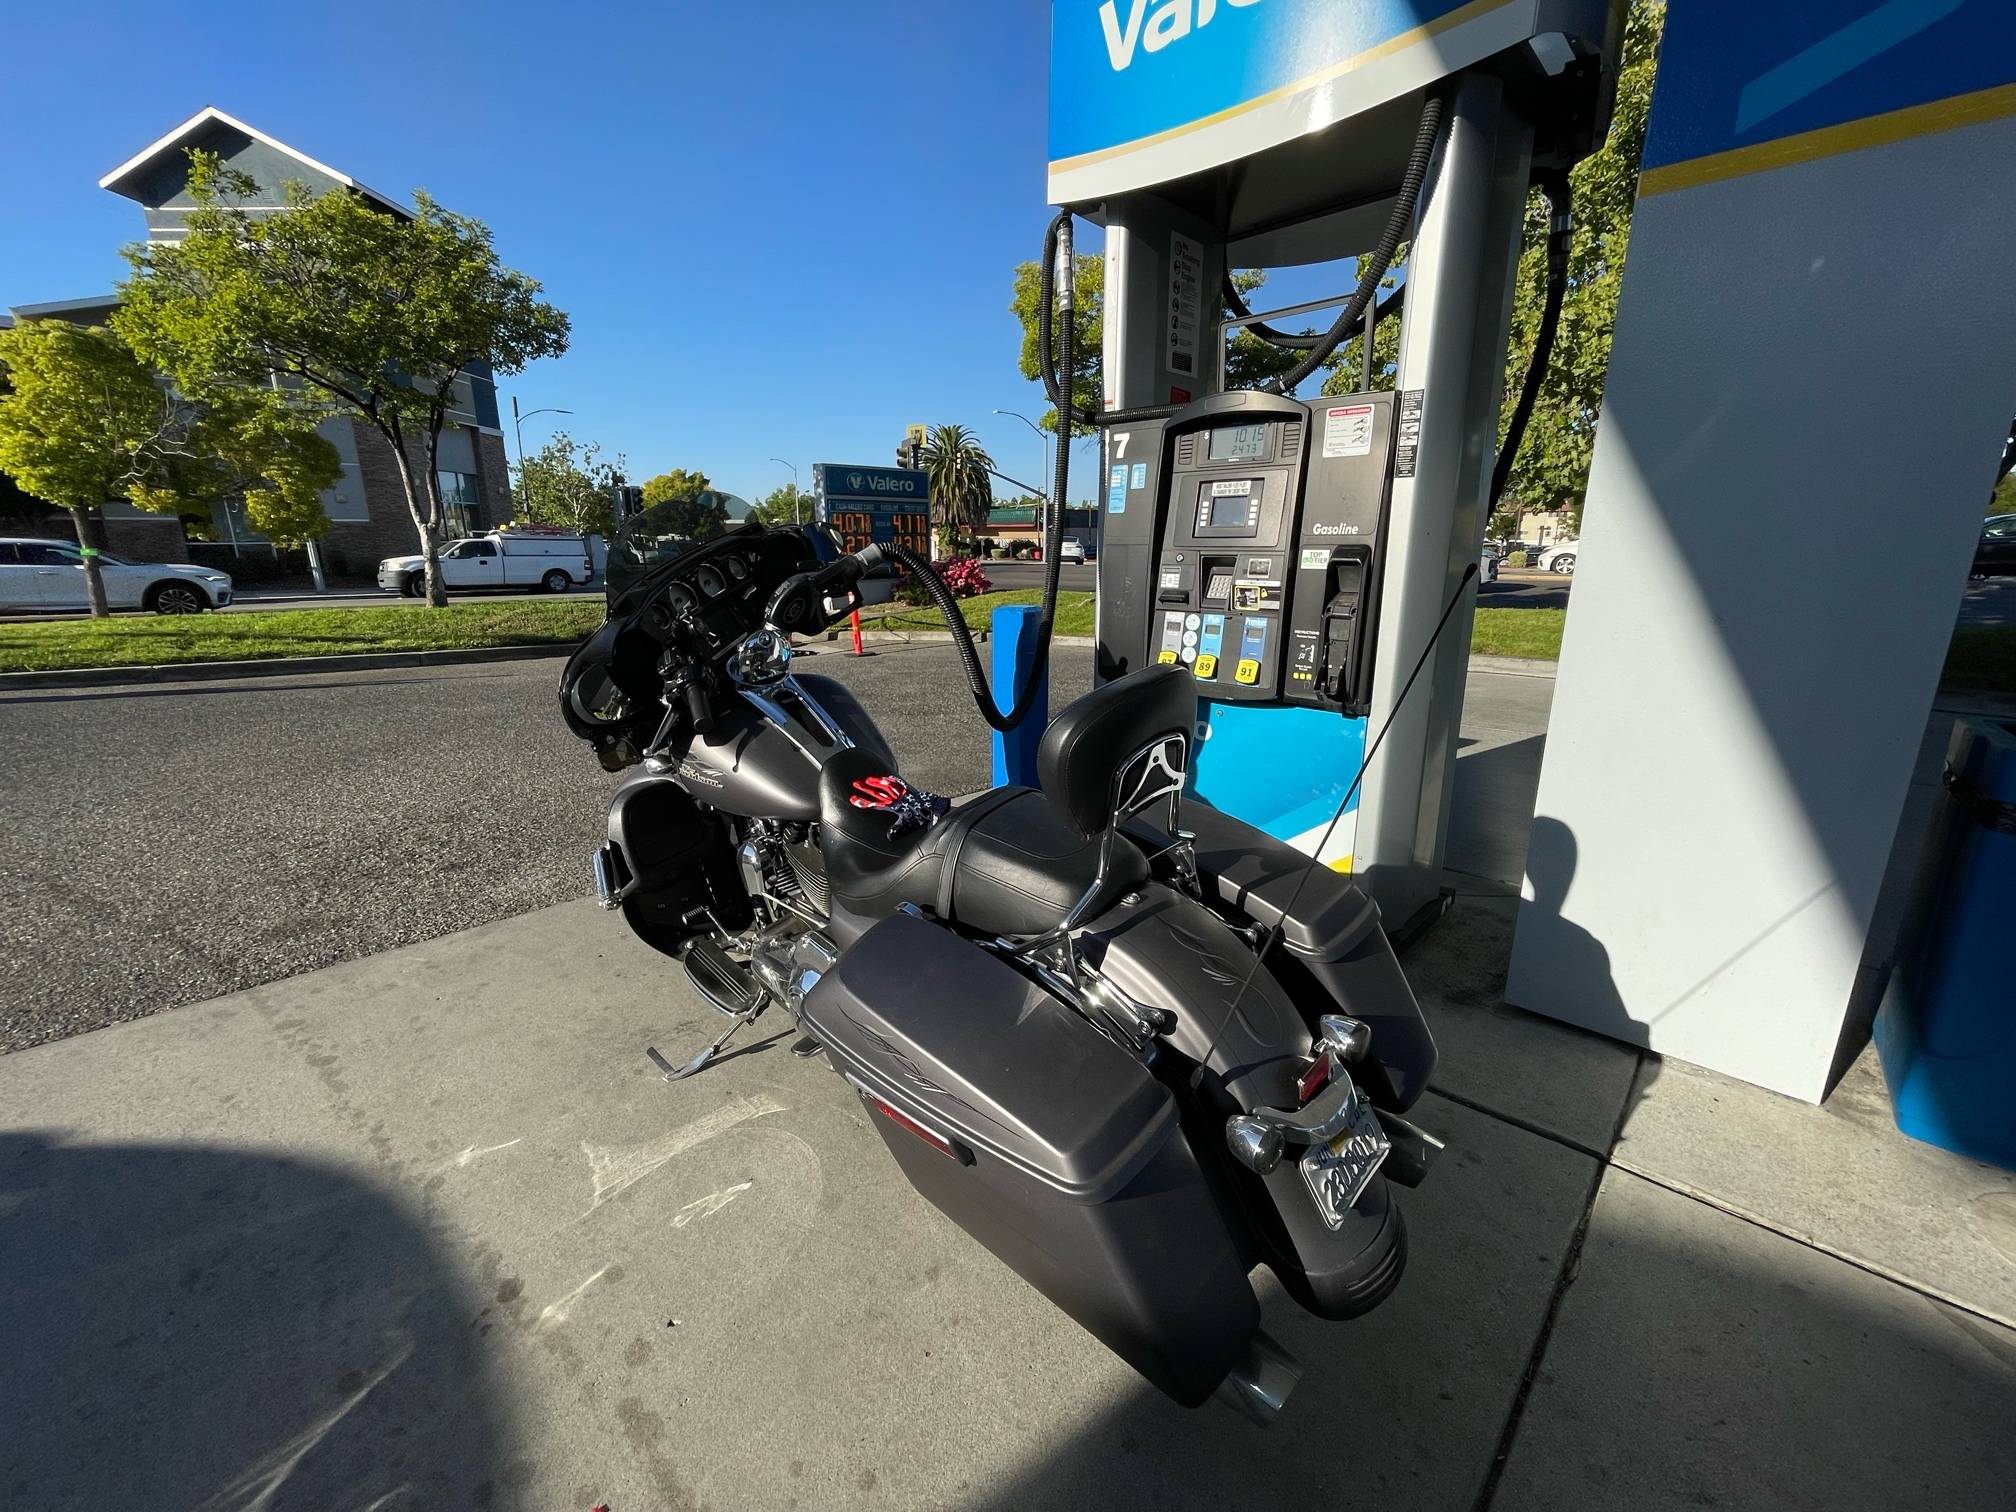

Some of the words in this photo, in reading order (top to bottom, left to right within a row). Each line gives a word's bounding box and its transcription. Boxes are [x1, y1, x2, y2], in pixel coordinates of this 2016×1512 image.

[1114, 433, 1130, 459] 7
[867, 475, 914, 492] Valero
[1313, 522, 1359, 536] Gasoline
[1198, 663, 1211, 672] 89
[1240, 667, 1253, 677] 91
